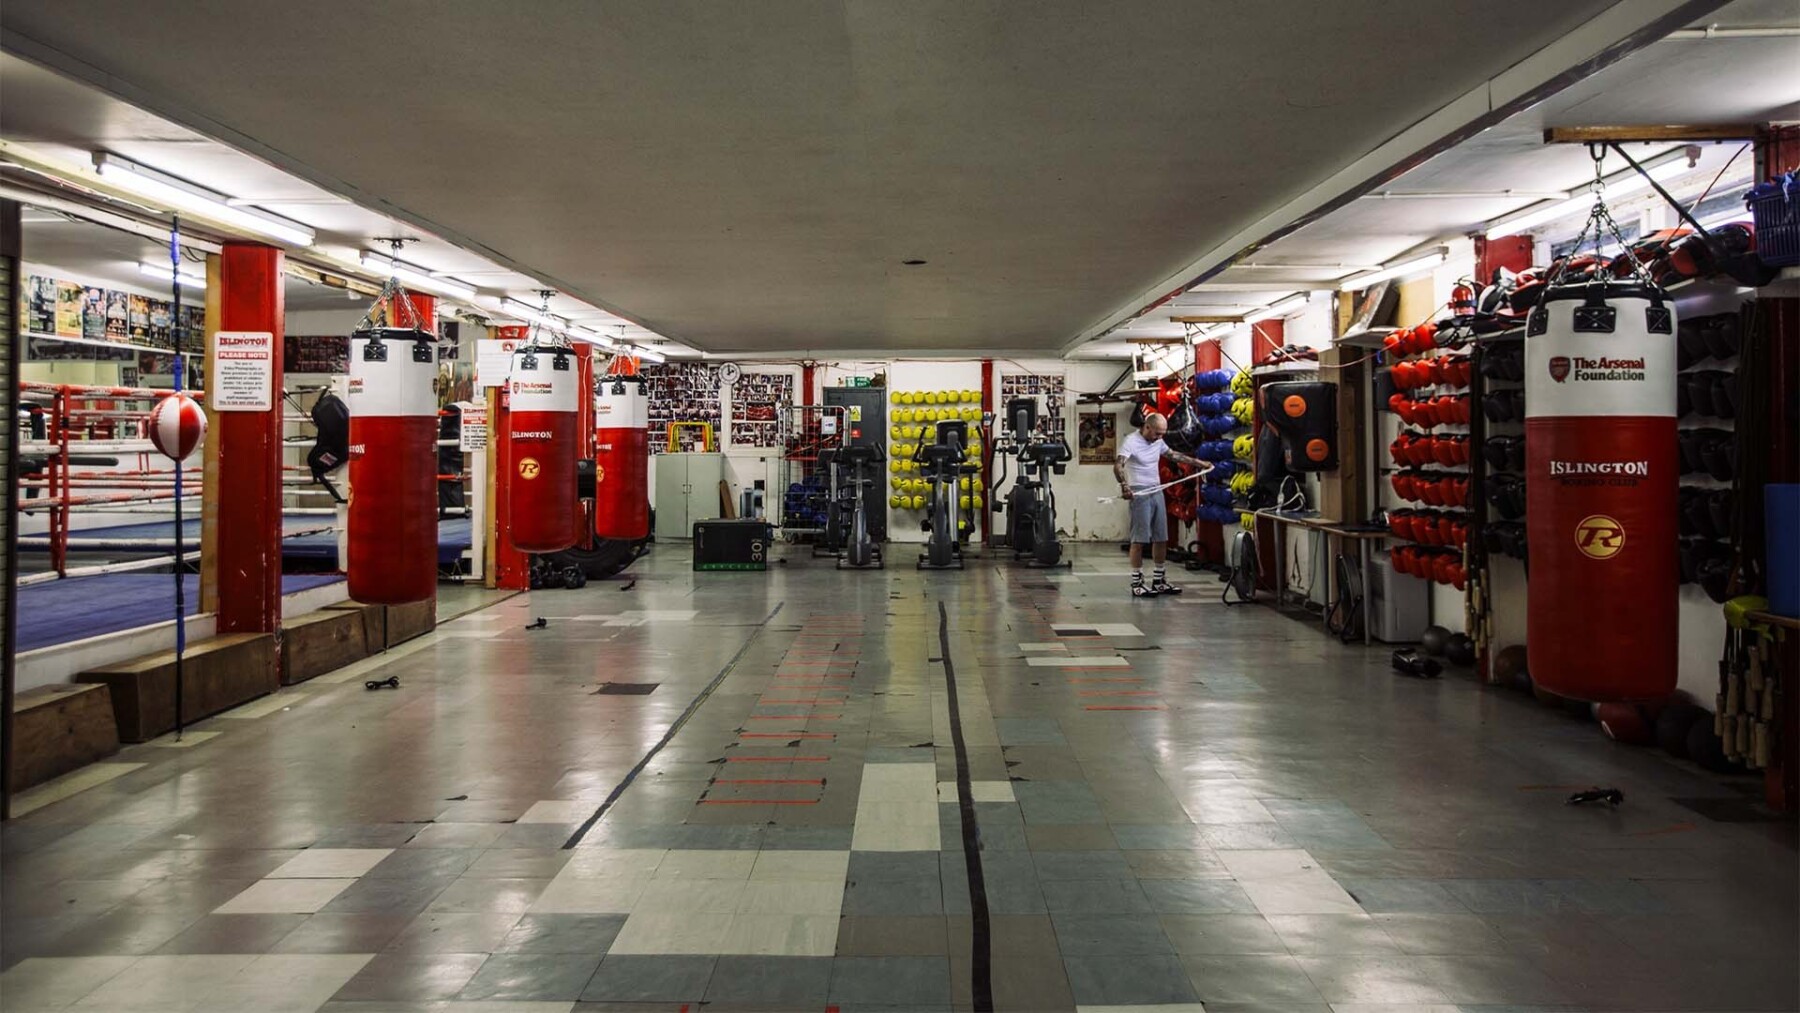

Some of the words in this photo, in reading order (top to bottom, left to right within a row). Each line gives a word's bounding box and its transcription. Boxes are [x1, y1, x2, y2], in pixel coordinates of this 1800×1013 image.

[219, 337, 268, 345] ISLINGTON
[1573, 357, 1597, 369] The
[1598, 356, 1645, 369] Arsenal
[1574, 370, 1645, 381] Foundation
[512, 431, 552, 439] ISLINGTON
[1550, 461, 1648, 476] ISLINGTON
